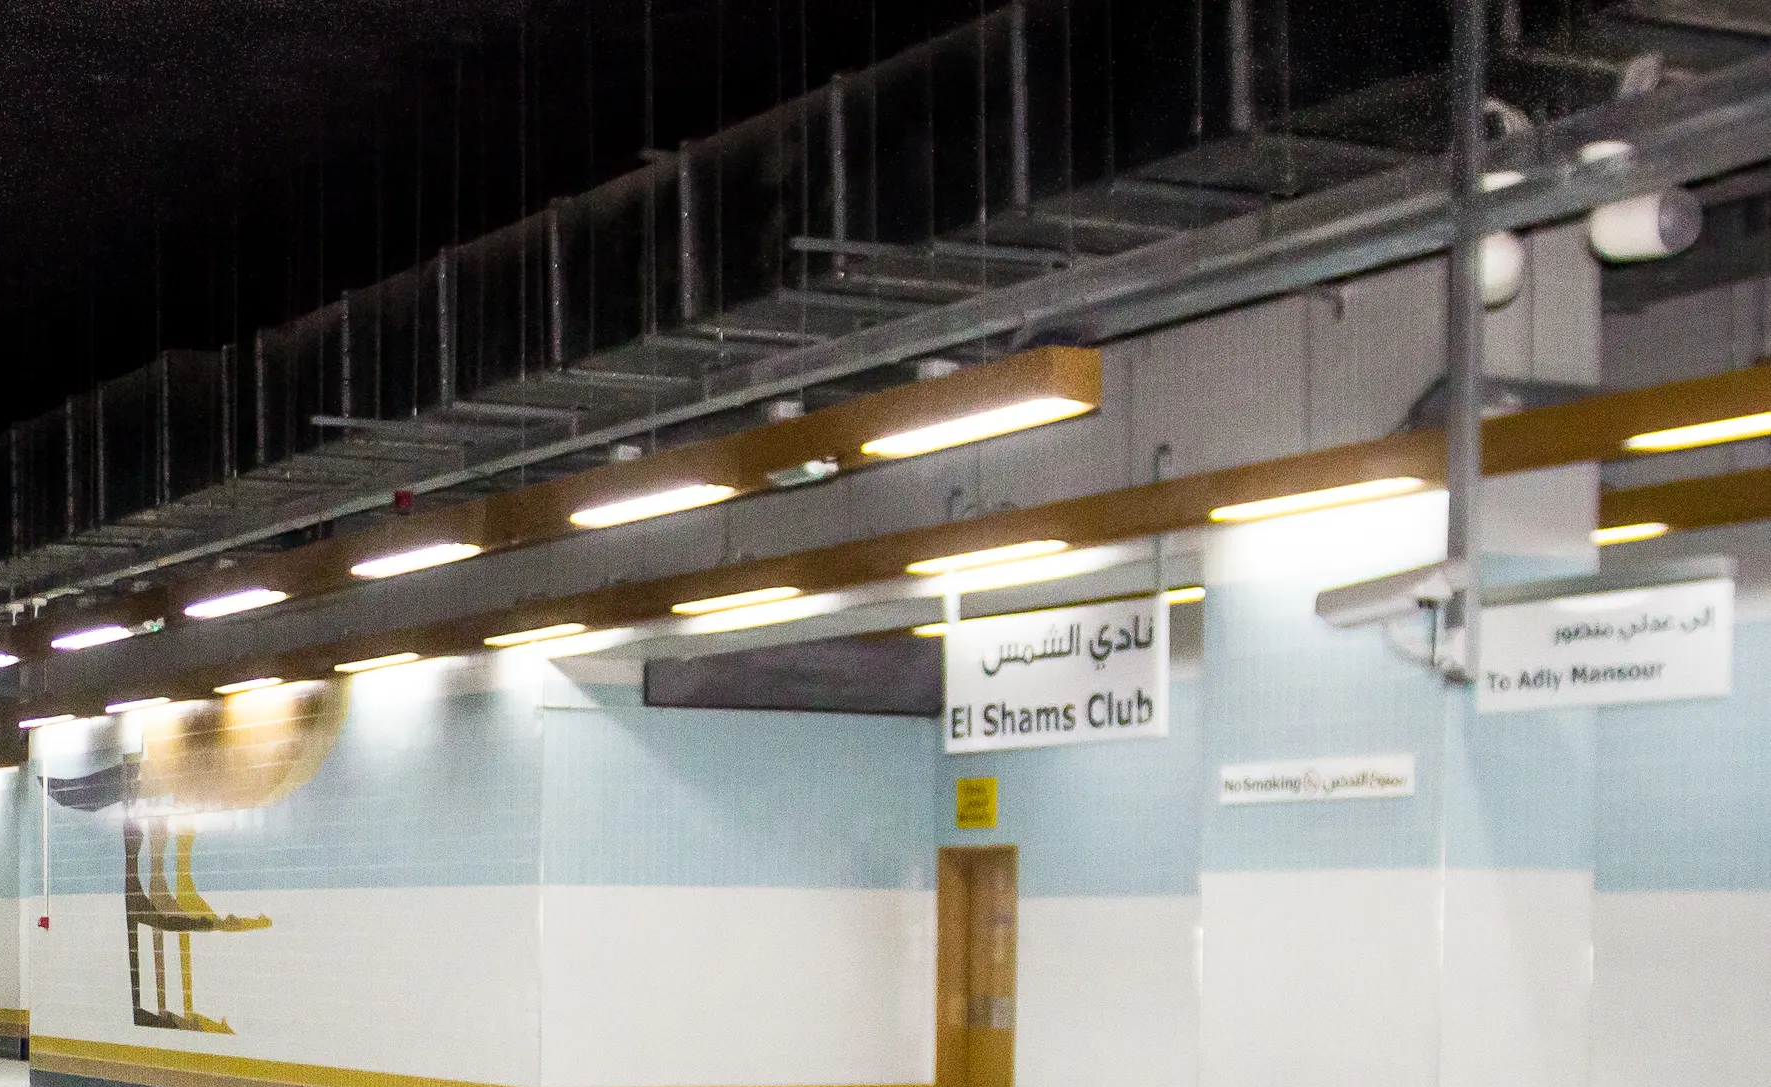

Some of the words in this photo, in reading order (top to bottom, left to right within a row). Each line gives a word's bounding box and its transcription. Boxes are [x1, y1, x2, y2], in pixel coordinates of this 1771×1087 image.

[982, 623, 1081, 677] الشمس
[1089, 614, 1154, 671] نادي
[1486, 671, 1512, 692] To
[1517, 667, 1563, 692] Adly
[1570, 662, 1666, 685] Mansour
[950, 704, 972, 739] El
[983, 701, 1077, 737] Shams
[1087, 687, 1154, 729] Club
[1243, 774, 1302, 793] Smoking
